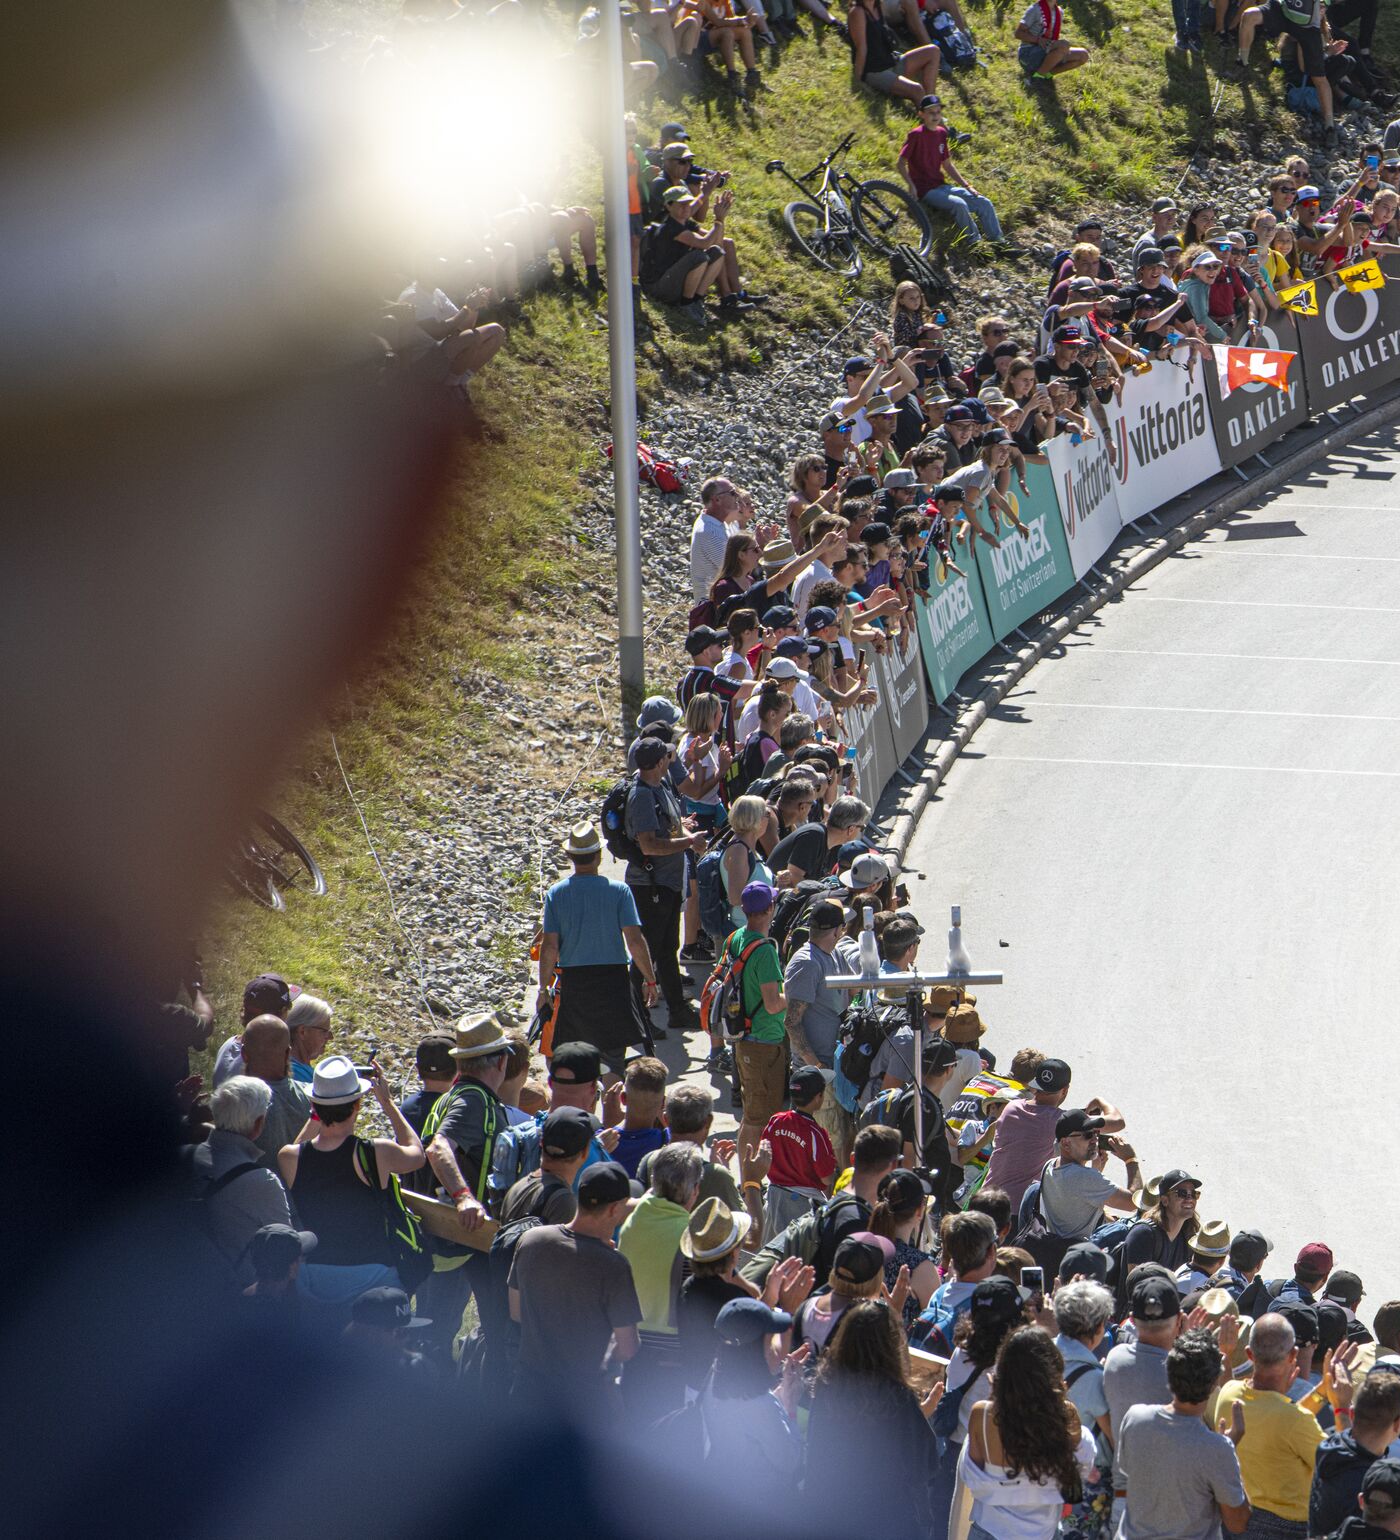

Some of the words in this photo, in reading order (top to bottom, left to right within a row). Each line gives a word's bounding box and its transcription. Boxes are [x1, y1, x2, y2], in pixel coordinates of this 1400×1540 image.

[1323, 330, 1400, 388] OAKLEY
[1128, 383, 1206, 468] vittoria
[1228, 382, 1297, 447] OAKLEY
[1073, 440, 1111, 521] vittoria
[990, 514, 1052, 588] MOTOREX
[1017, 556, 1057, 597] Switzerland
[927, 576, 973, 648] MOTOREX
[775, 1129, 807, 1148] SUISSE
